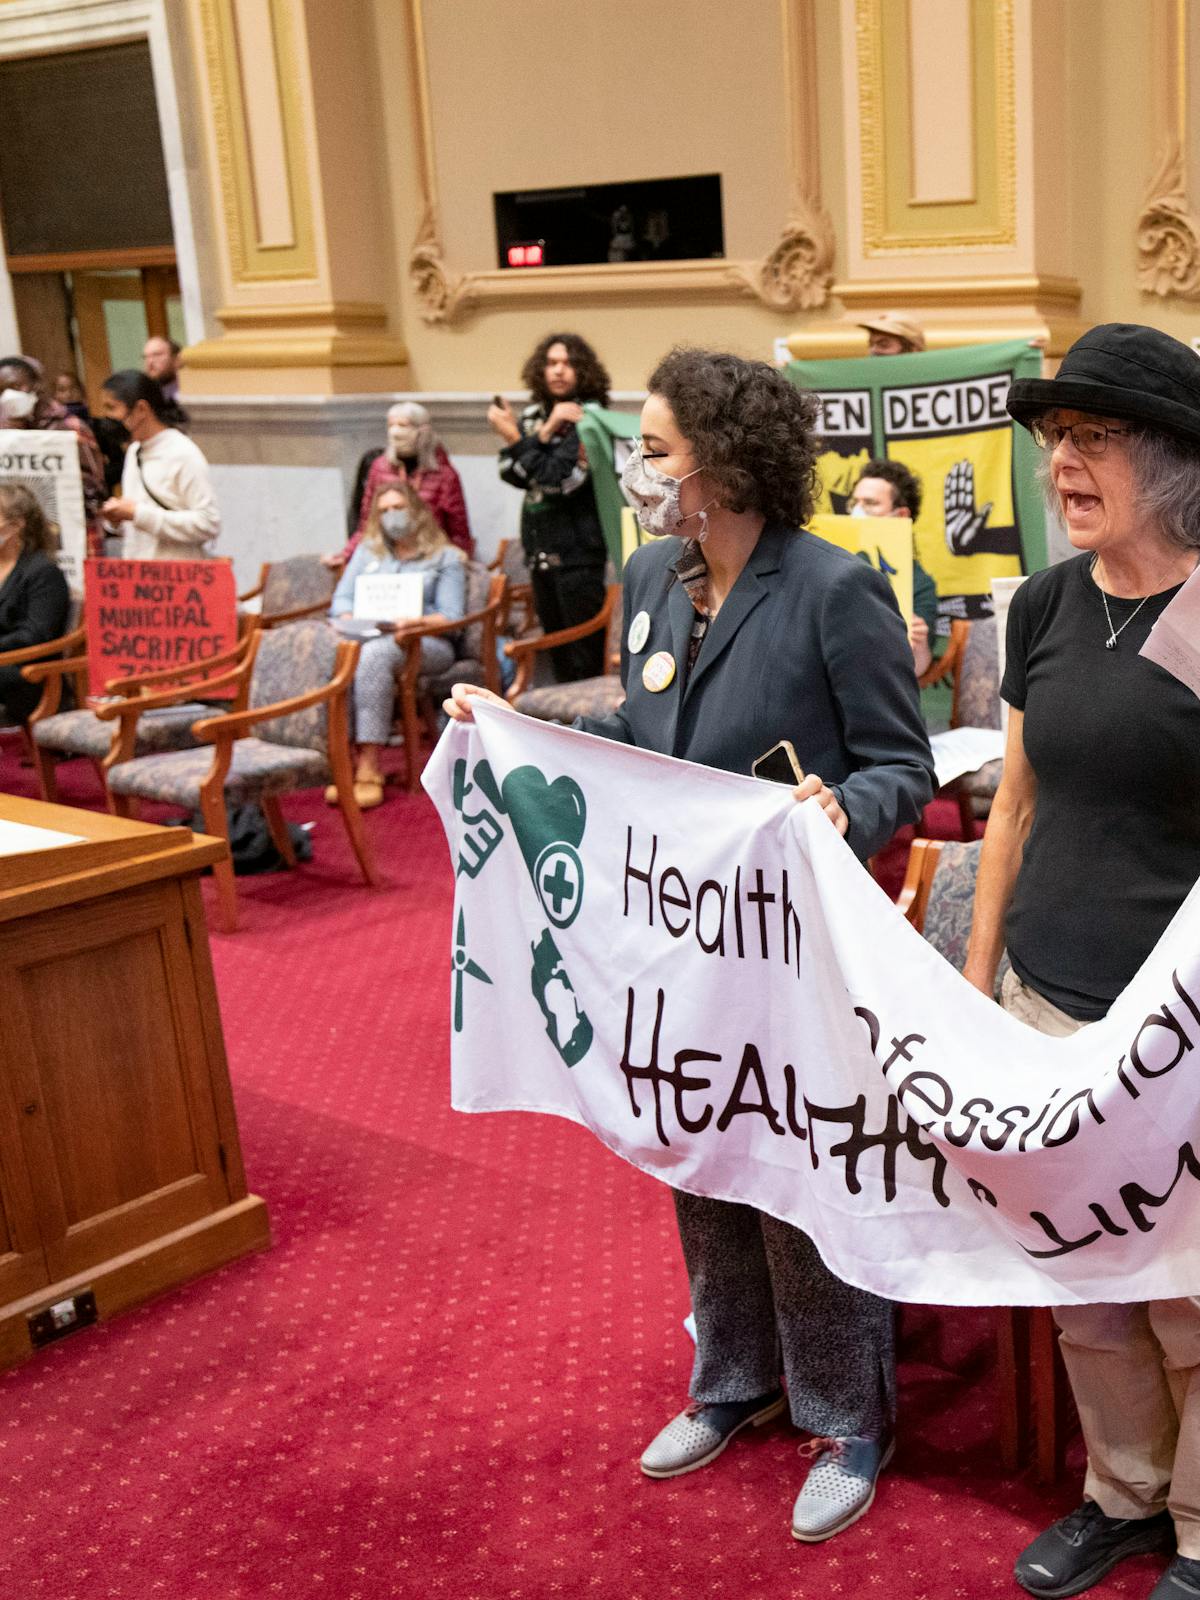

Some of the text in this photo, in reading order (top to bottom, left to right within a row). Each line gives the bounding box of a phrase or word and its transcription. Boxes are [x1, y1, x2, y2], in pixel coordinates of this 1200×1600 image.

[823, 381, 1008, 431] EN DECIDE
[0, 454, 65, 472] OTECT
[96, 561, 134, 579] EAST
[140, 563, 215, 586] PHILLIPS
[102, 583, 205, 604] IS NOT A
[98, 604, 210, 628] MUNICIPAL
[623, 825, 801, 980] Health
[620, 986, 950, 1208] HEALTHY
